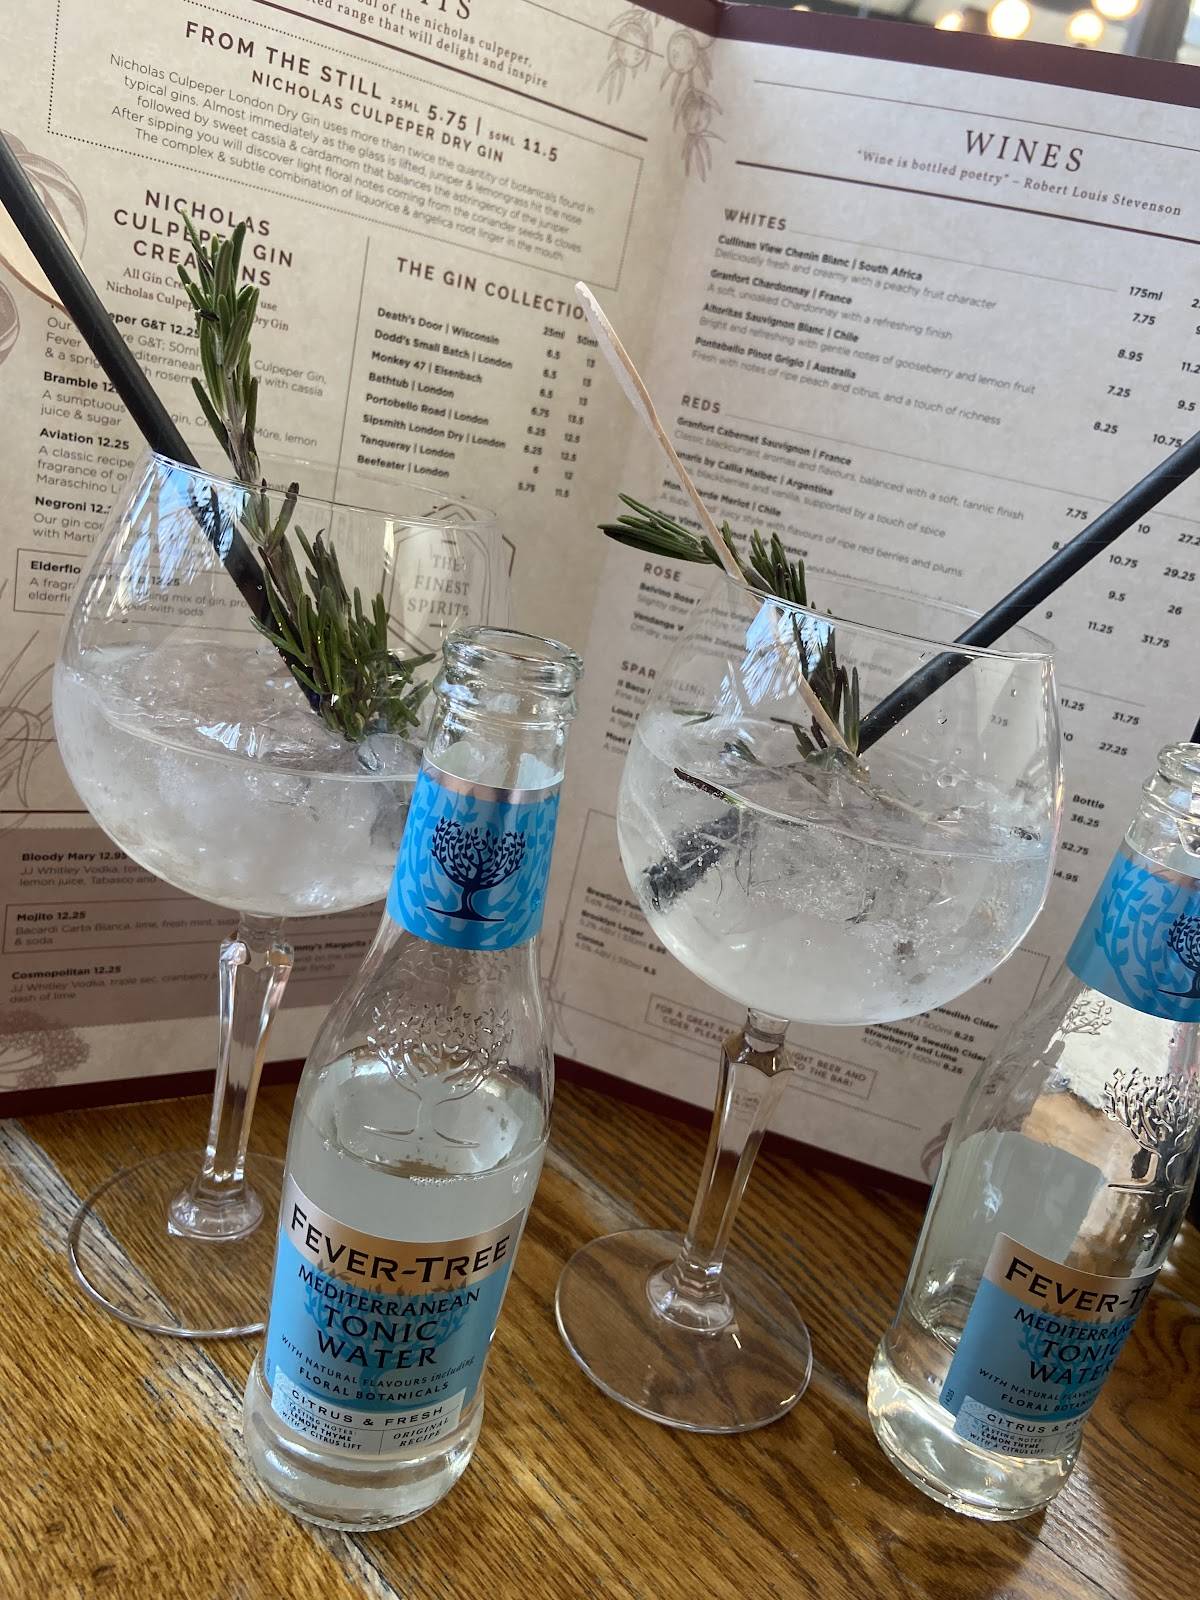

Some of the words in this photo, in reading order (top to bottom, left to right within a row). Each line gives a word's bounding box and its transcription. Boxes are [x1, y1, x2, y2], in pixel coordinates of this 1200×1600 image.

[381, 3, 395, 15] of
[400, 8, 420, 24] the
[424, 19, 475, 45] nicholas
[337, 4, 374, 25] range
[378, 16, 404, 36] that
[408, 29, 433, 45] will
[436, 38, 478, 63] delight
[478, 54, 504, 72] and
[507, 64, 547, 88] inspire
[186, 20, 254, 58] FROM
[265, 46, 310, 76] THE
[320, 65, 381, 100] STILL
[110, 53, 165, 80] Nicholas
[167, 71, 226, 97] Culpeper
[226, 88, 274, 112] London
[277, 103, 298, 121] Dry
[301, 112, 320, 127] Gin
[323, 120, 348, 136] uses
[351, 129, 379, 145] more
[382, 138, 405, 153] than
[124, 76, 167, 96] typical
[168, 89, 199, 107] gins.
[202, 98, 246, 120] Almost
[249, 111, 319, 144] immediately
[252, 69, 343, 110] NICHOLAS
[350, 102, 435, 140] CULPEPER
[441, 132, 472, 152] DRY
[477, 144, 503, 162] GIN
[112, 106, 144, 124] After
[147, 116, 193, 139] sipping
[196, 130, 219, 145] you
[222, 138, 243, 151] will
[245, 143, 294, 166] discover
[137, 93, 192, 120] followed
[211, 119, 248, 137] sweet
[251, 130, 286, 148] cassia
[300, 146, 360, 170] cardamom
[390, 96, 419, 113] 25ML
[427, 104, 467, 131] 5.75
[523, 138, 558, 162] 11.5
[136, 128, 159, 144] The
[162, 138, 214, 160] complex
[228, 155, 266, 174] subtle
[268, 167, 338, 195] combination
[966, 129, 1083, 172] WINES
[911, 158, 957, 176] bottled
[1023, 177, 1068, 196] Robert
[1071, 186, 1108, 202] Louis
[1112, 193, 1181, 216] Stevenson
[145, 189, 271, 236] NICHOLAS
[724, 208, 786, 231] WHITES
[254, 244, 294, 268] GIN
[397, 256, 435, 281] THE
[443, 270, 477, 292] GIN
[858, 260, 889, 274] South
[890, 267, 923, 281] Africa
[106, 280, 154, 300] Nicholas
[818, 290, 853, 305] France
[1129, 286, 1163, 300] 175ml
[140, 317, 167, 331] G&T
[418, 317, 444, 331] Door
[1132, 312, 1156, 326] 7.75
[46, 331, 83, 348] Fever
[371, 350, 411, 369] Monkey
[413, 360, 426, 370] 47
[412, 338, 441, 352] Small
[477, 353, 512, 369] London
[1117, 349, 1144, 362] 8.95
[254, 359, 304, 378] Culpeper
[43, 371, 98, 390] Bramble
[368, 372, 409, 389] Bathtub
[417, 382, 454, 399] London
[56, 393, 128, 413] sumptuous
[681, 394, 720, 414] REDS
[1106, 384, 1132, 398] 7.25
[1177, 400, 1196, 412] 9.5
[86, 413, 122, 426] sugar
[453, 411, 489, 425] London
[39, 428, 93, 445] Aviation
[97, 436, 129, 450] 12.25
[362, 414, 406, 430] Sipsmith
[408, 422, 445, 437] London
[447, 429, 464, 442] Dry
[471, 435, 506, 448] London
[1094, 422, 1118, 434] 8.25
[1152, 434, 1182, 448] 10.75
[360, 434, 412, 453] Tanqueray
[419, 445, 455, 459] London
[50, 447, 94, 463] classic
[96, 455, 135, 473] recipe
[36, 473, 108, 493] Maraschino
[35, 496, 86, 512] Negroni
[1066, 508, 1088, 520] 7.75
[1136, 524, 1150, 534] 10
[30, 560, 82, 574] Elderflo
[643, 562, 681, 582] ROSE
[1109, 554, 1138, 568] 10.75
[1163, 567, 1196, 582] 29.25
[414, 576, 470, 596] FINEST
[408, 598, 469, 616] SPIRITS
[1108, 590, 1126, 602] 9.5
[1168, 604, 1182, 616] 26
[1088, 620, 1114, 635] 11.25
[1141, 634, 1170, 648] 31.75
[1061, 698, 1085, 712] 11.25
[1112, 711, 1140, 726] 31.75
[1100, 742, 1128, 756] 27.25
[1072, 794, 1104, 810] Bottle
[1070, 813, 1100, 828] 36.25
[22, 852, 64, 862] Bloody
[68, 852, 95, 861] Mary
[1062, 841, 1089, 856] 52.75
[16, 912, 54, 922] Mojito
[57, 911, 86, 920] 12.25
[11, 968, 90, 980] Cosmopolitan
[94, 965, 121, 975] 12.25
[290, 1203, 512, 1283] FEVER-TREE
[298, 1264, 480, 1318] MEDITERRANEAN
[324, 1306, 440, 1344] TONIC
[317, 1330, 438, 1370] WATER
[281, 1336, 302, 1359] WITH
[306, 1357, 358, 1384] NATURAL
[363, 1376, 428, 1388] FLAVOURS
[430, 1356, 476, 1382] including
[299, 1366, 350, 1396] FLORAL
[356, 1381, 450, 1400] BOTANICALS
[980, 1368, 1008, 1387] WITH
[1011, 1384, 1059, 1400] NATURAL
[291, 1389, 353, 1424] CITRUS
[384, 1406, 444, 1426] FRESH
[1001, 1394, 1048, 1412] FLORAL
[290, 1410, 318, 1432] LEMON
[320, 1428, 352, 1442] THYME
[394, 1417, 448, 1440] ORIGINAL
[987, 1414, 1044, 1433] CITRUS
[310, 1430, 341, 1448] CITRUS
[400, 1430, 442, 1448] RECIPE
